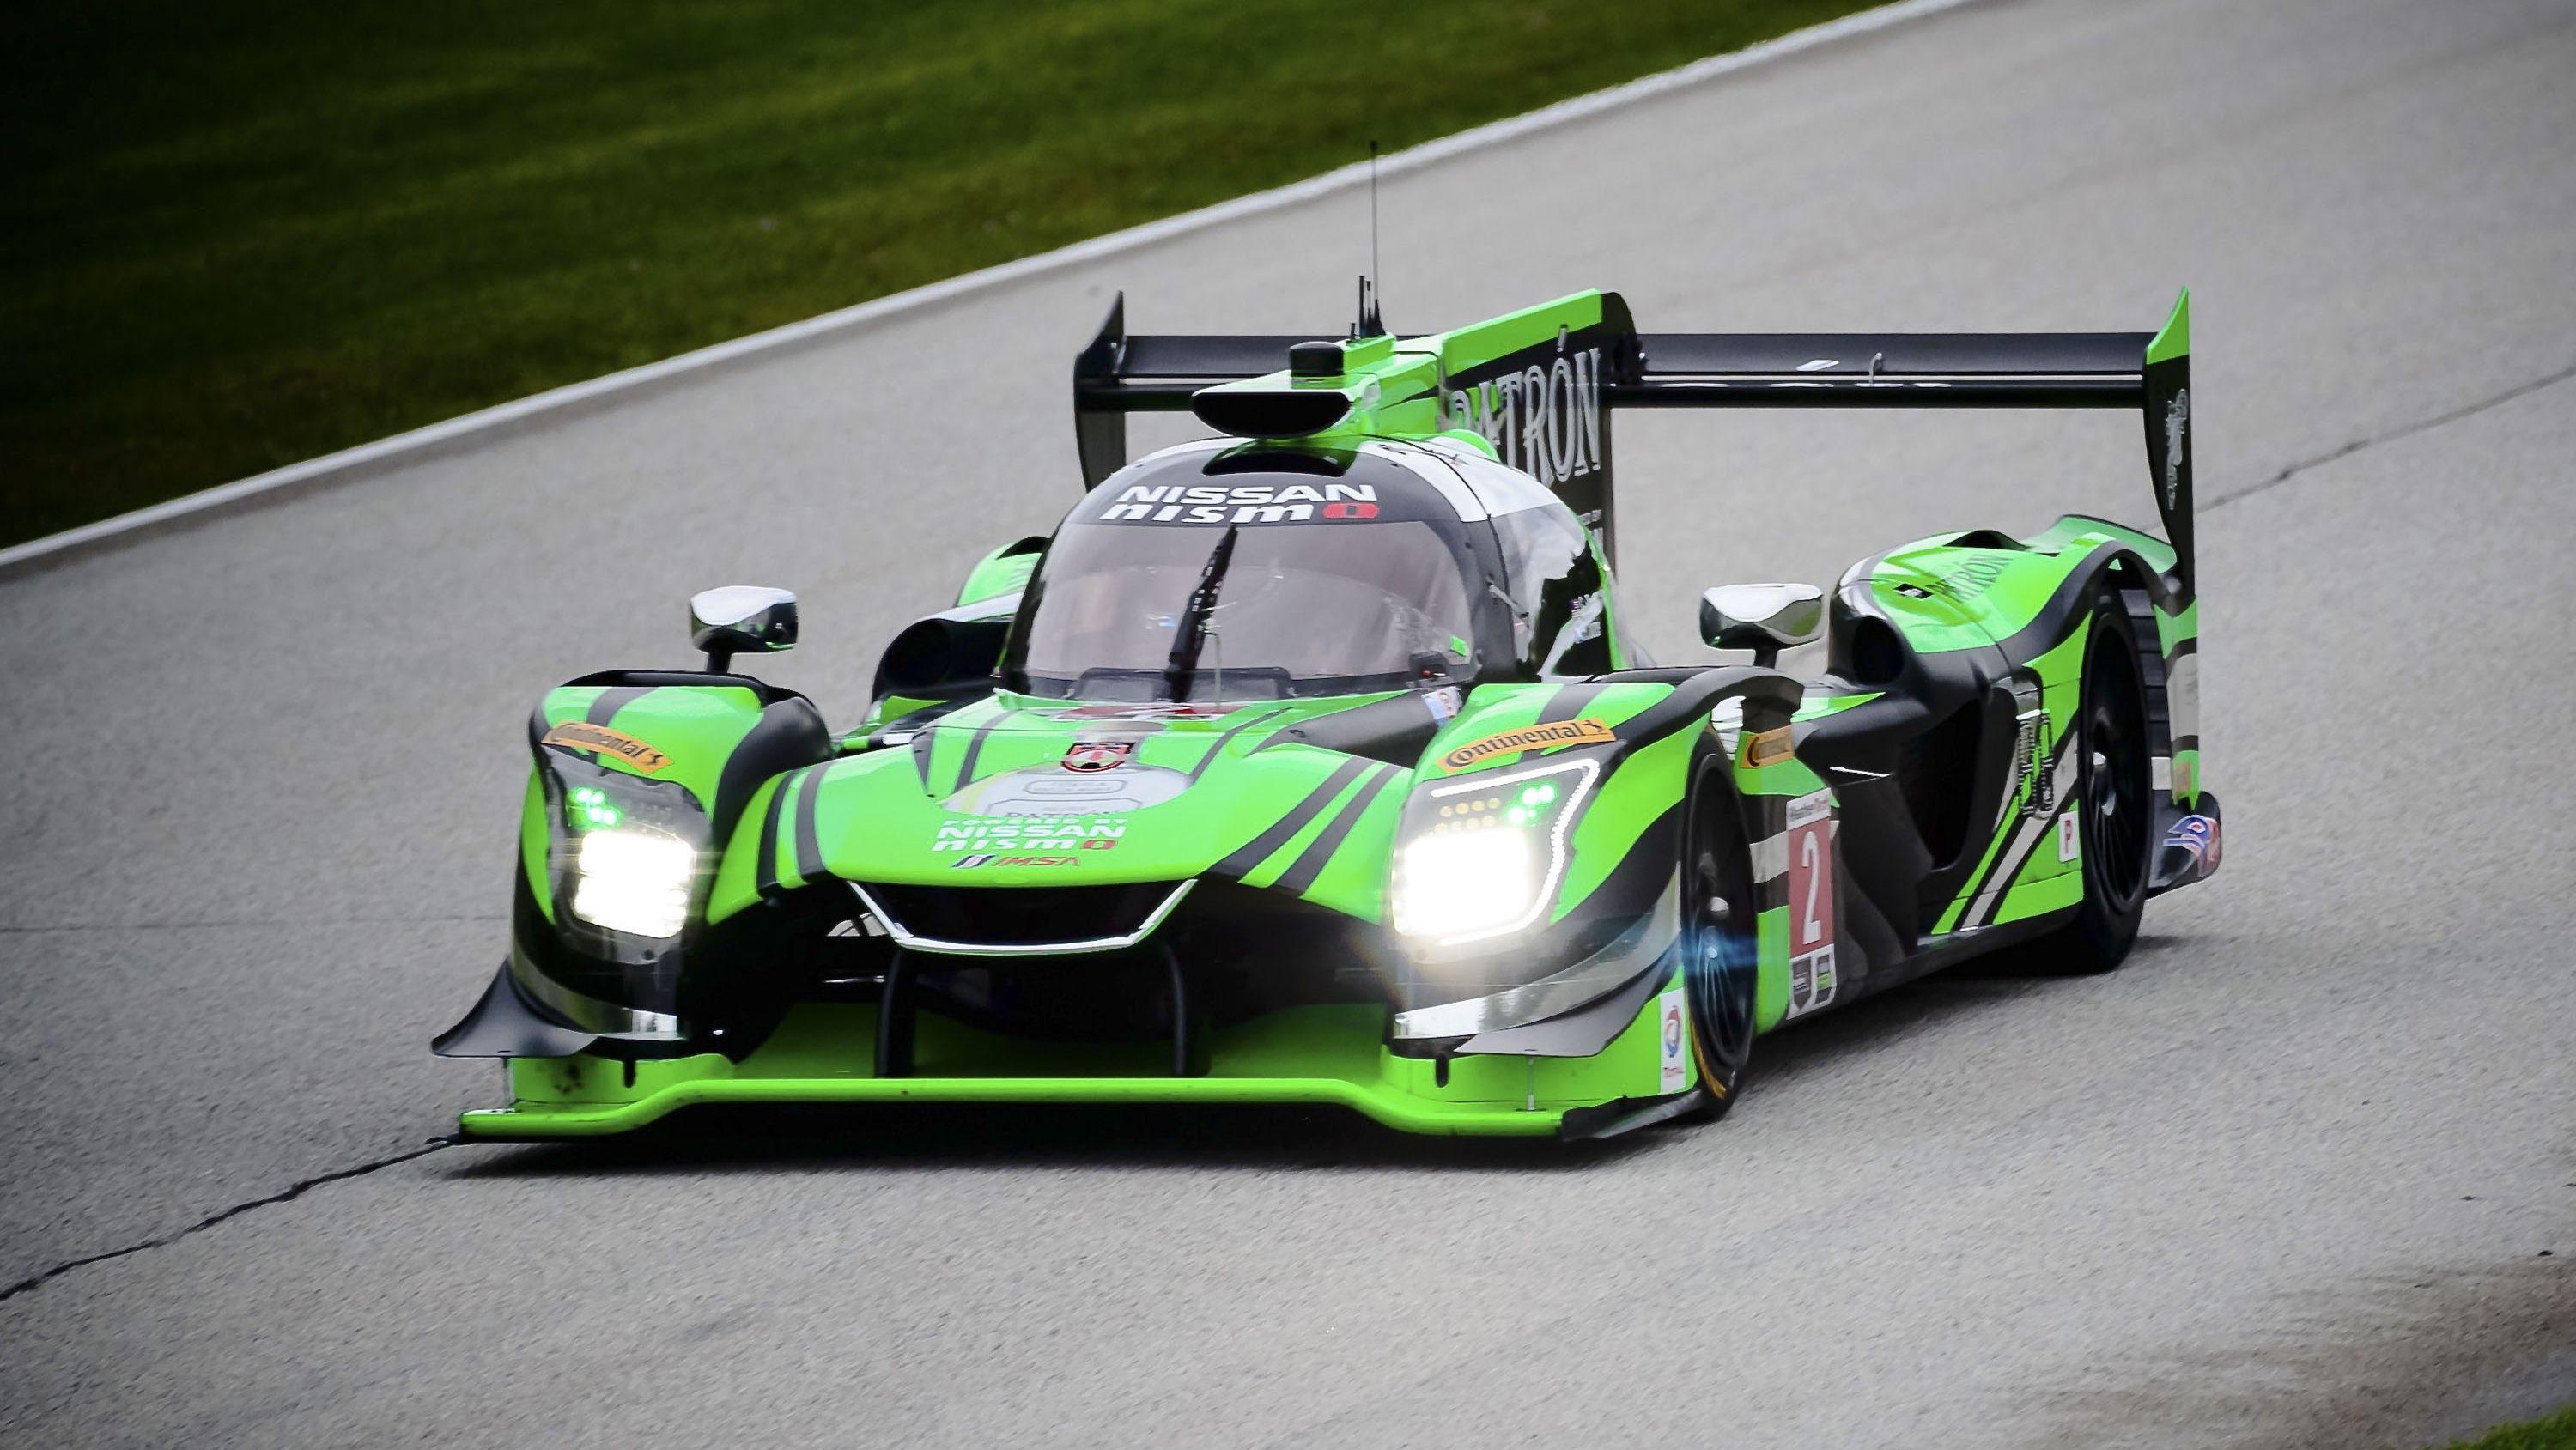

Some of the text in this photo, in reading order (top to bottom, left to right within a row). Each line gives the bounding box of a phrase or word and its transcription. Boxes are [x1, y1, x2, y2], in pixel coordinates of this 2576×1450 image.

[1116, 484, 1377, 504] NISSAN
[1446, 723, 1585, 767] Continental
[937, 825, 1127, 839] NISSAN
[1802, 831, 1821, 945] 2
